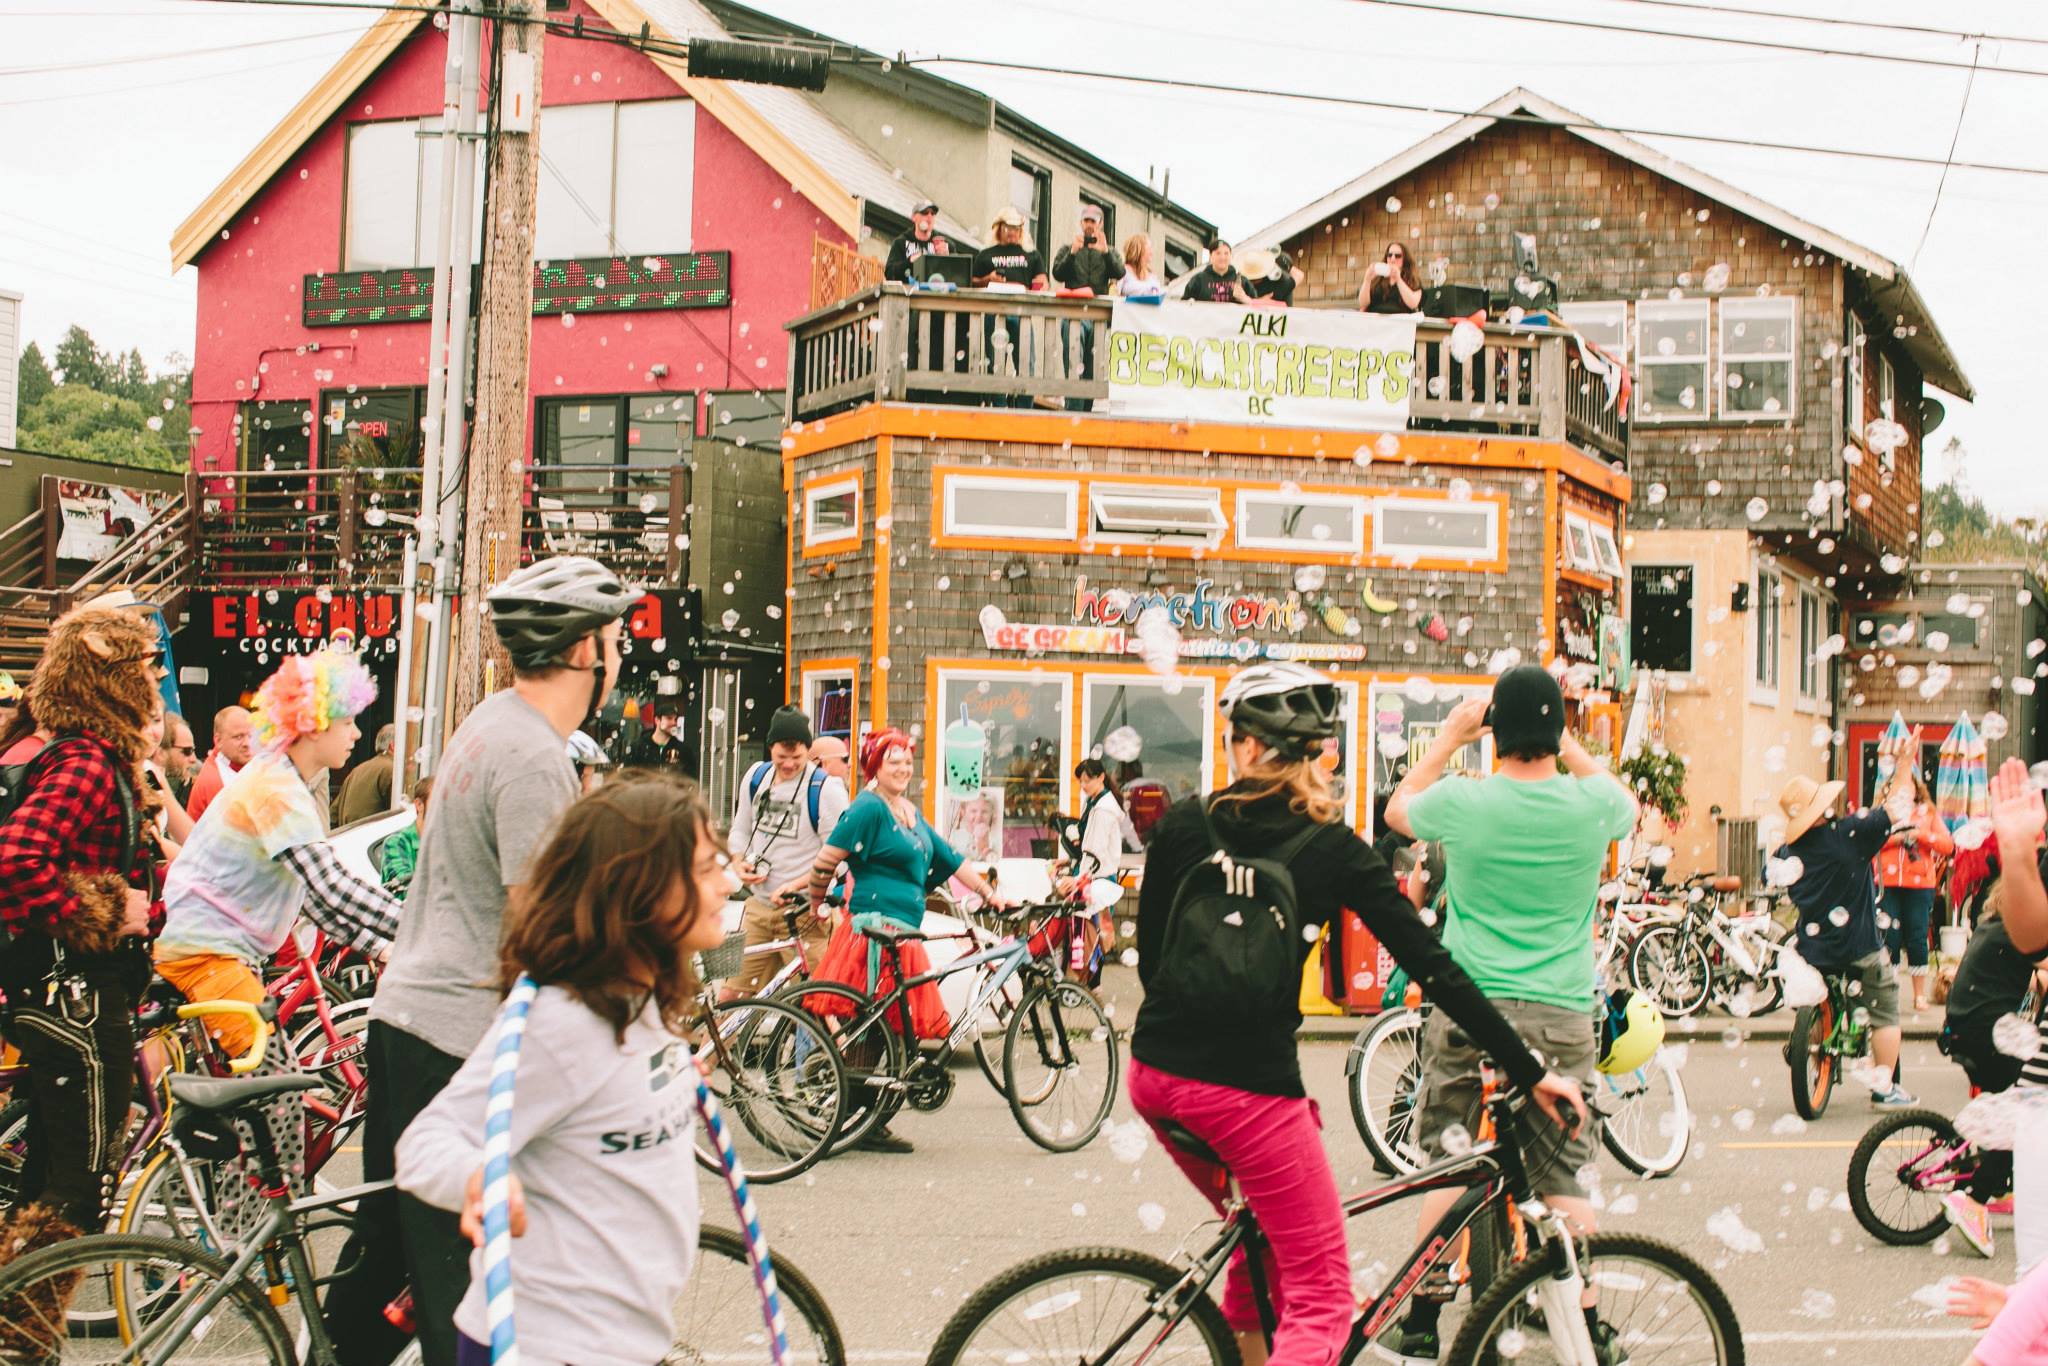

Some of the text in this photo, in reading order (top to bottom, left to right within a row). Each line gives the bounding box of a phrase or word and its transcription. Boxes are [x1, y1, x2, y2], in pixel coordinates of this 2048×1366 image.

[1240, 313, 1288, 337] ALKI
[1109, 332, 1416, 403] BEACHCREEPS
[1248, 396, 1275, 416] BC
[358, 421, 388, 438] OPEN
[1660, 568, 1690, 582] BEAH
[213, 596, 266, 638] EL
[1034, 627, 1122, 652] CREAM
